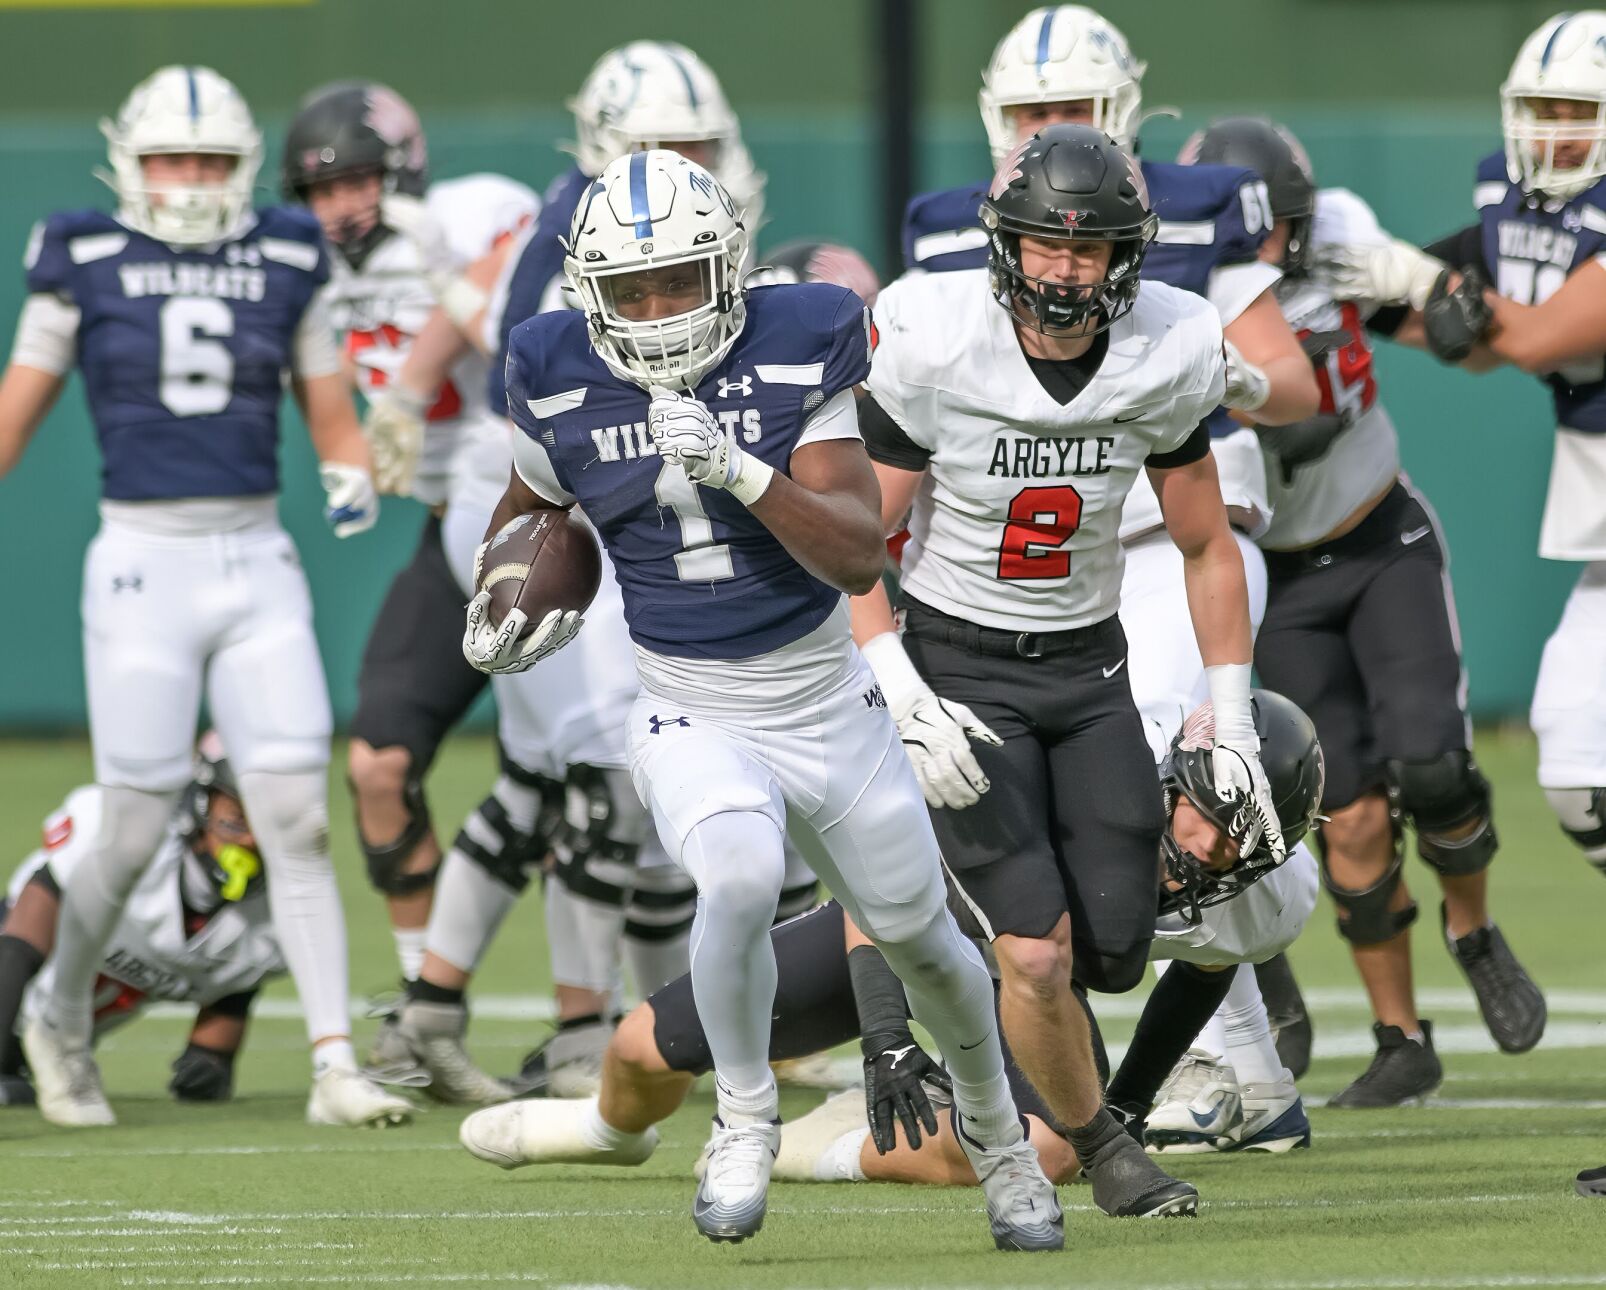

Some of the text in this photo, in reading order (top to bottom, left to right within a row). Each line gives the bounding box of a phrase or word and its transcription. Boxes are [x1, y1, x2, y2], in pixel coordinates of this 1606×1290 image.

[160, 297, 234, 417] 6
[591, 408, 762, 463] WILTS
[987, 437, 1114, 478] ARGYLE
[654, 463, 734, 582] 1
[997, 485, 1083, 580] 2
